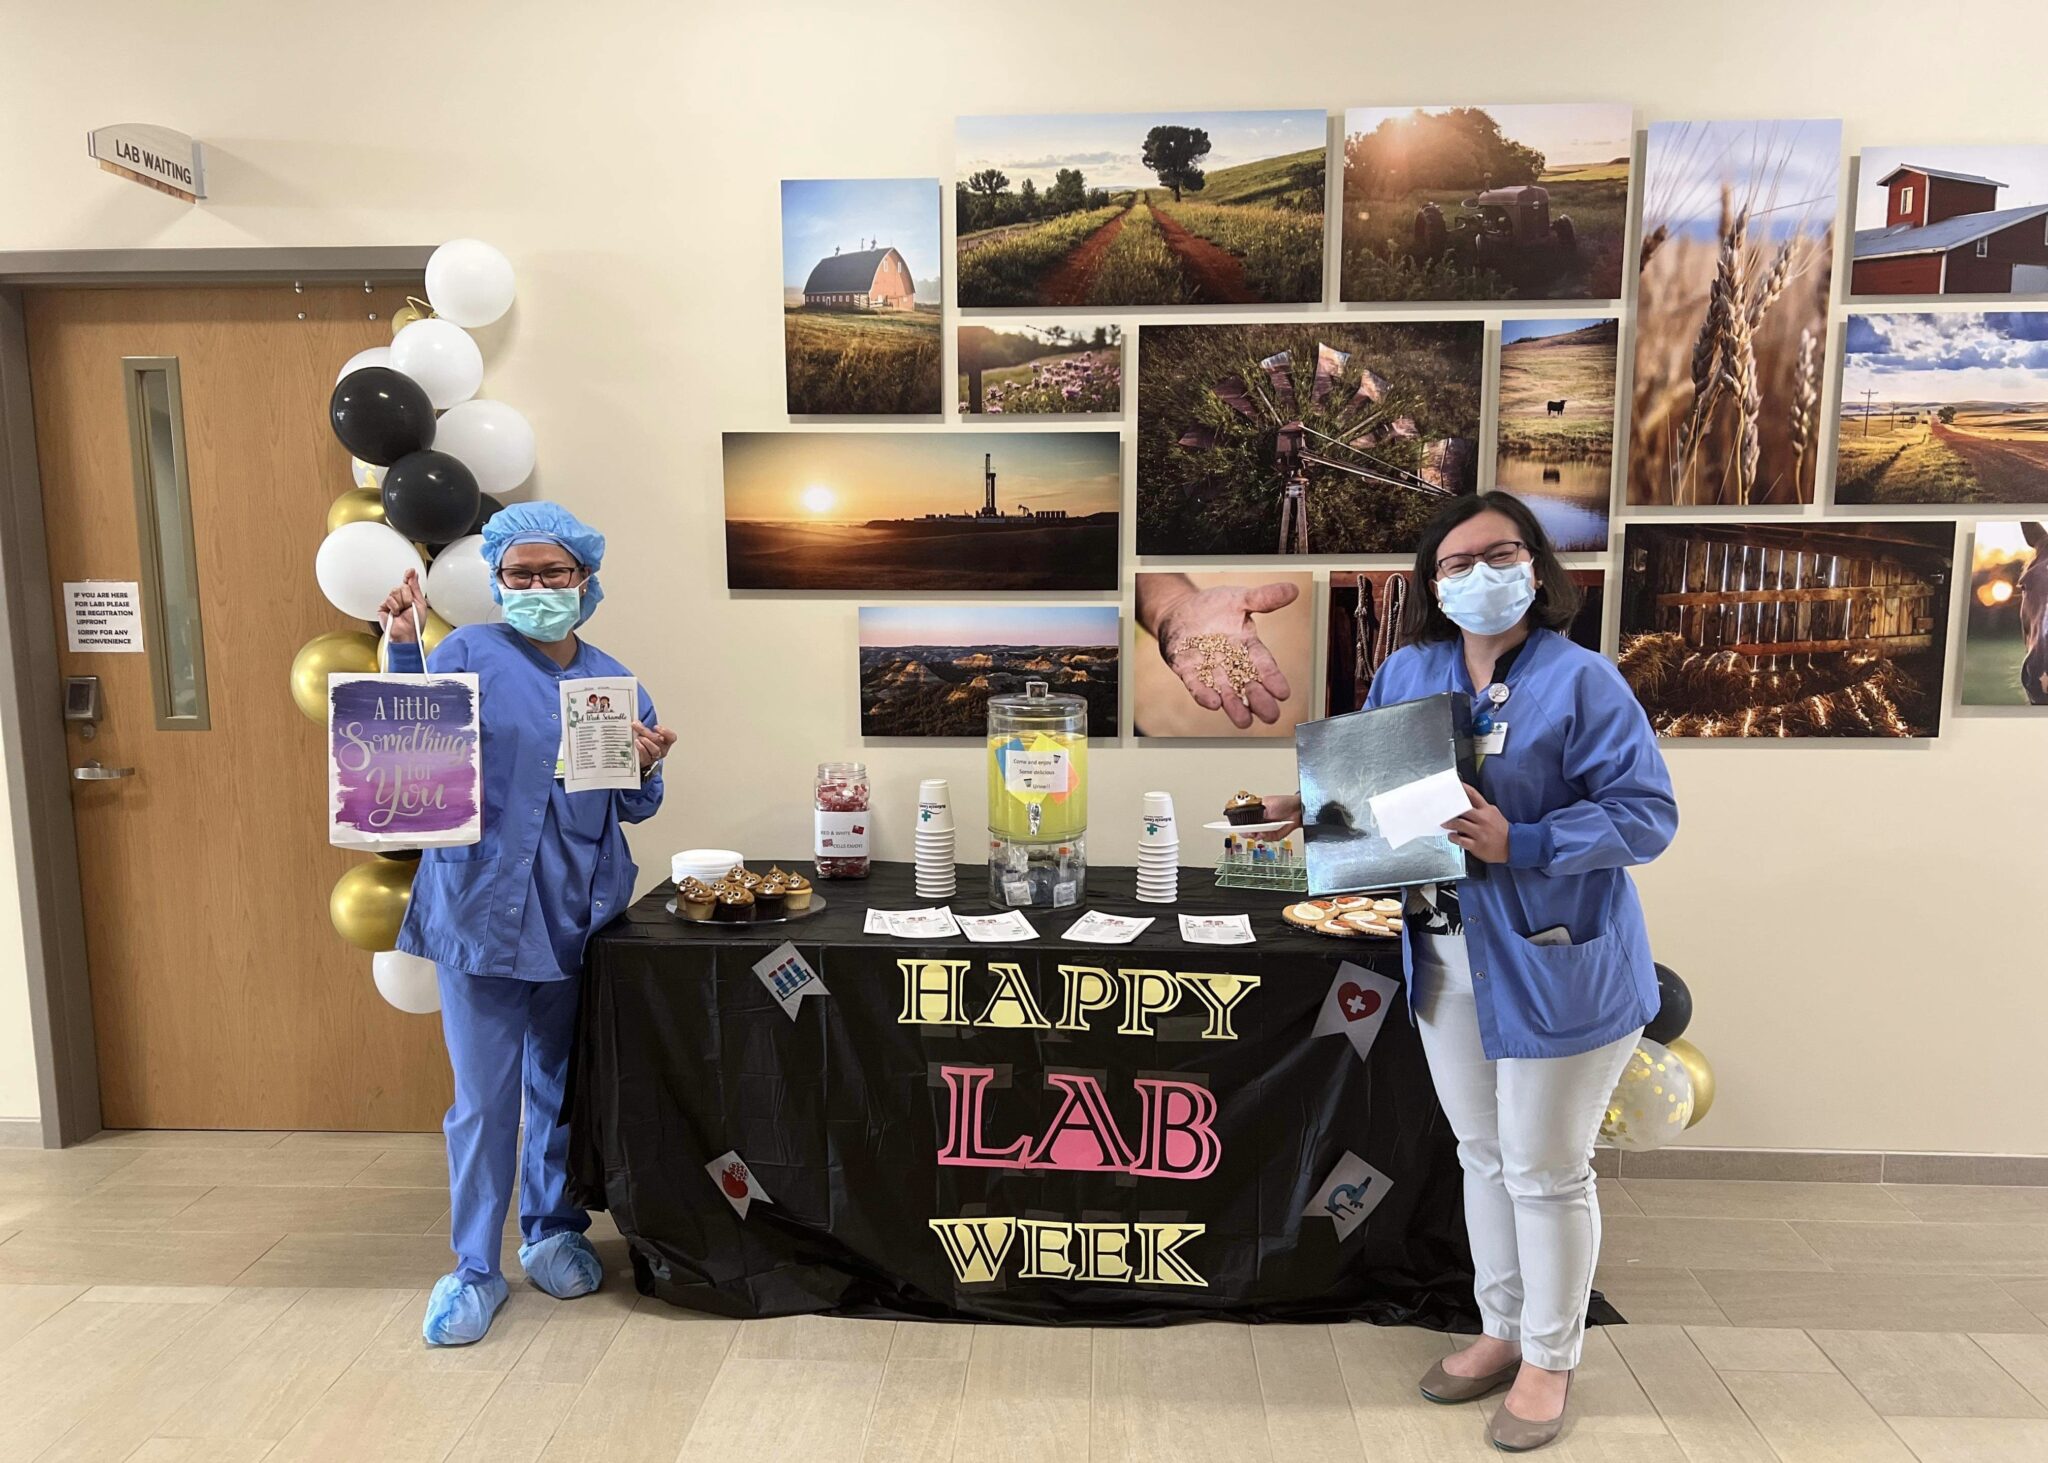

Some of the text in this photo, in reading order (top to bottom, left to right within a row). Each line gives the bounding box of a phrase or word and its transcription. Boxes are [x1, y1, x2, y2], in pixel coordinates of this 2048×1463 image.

[115, 138, 192, 185] LAB WAITING
[373, 696, 441, 721] A little
[338, 721, 467, 771] Something
[407, 763, 432, 781] for
[365, 764, 448, 827] You
[897, 958, 1261, 1040] HAPPY
[937, 1065, 1222, 1179] LAB
[928, 1216, 1209, 1287] WEEK
